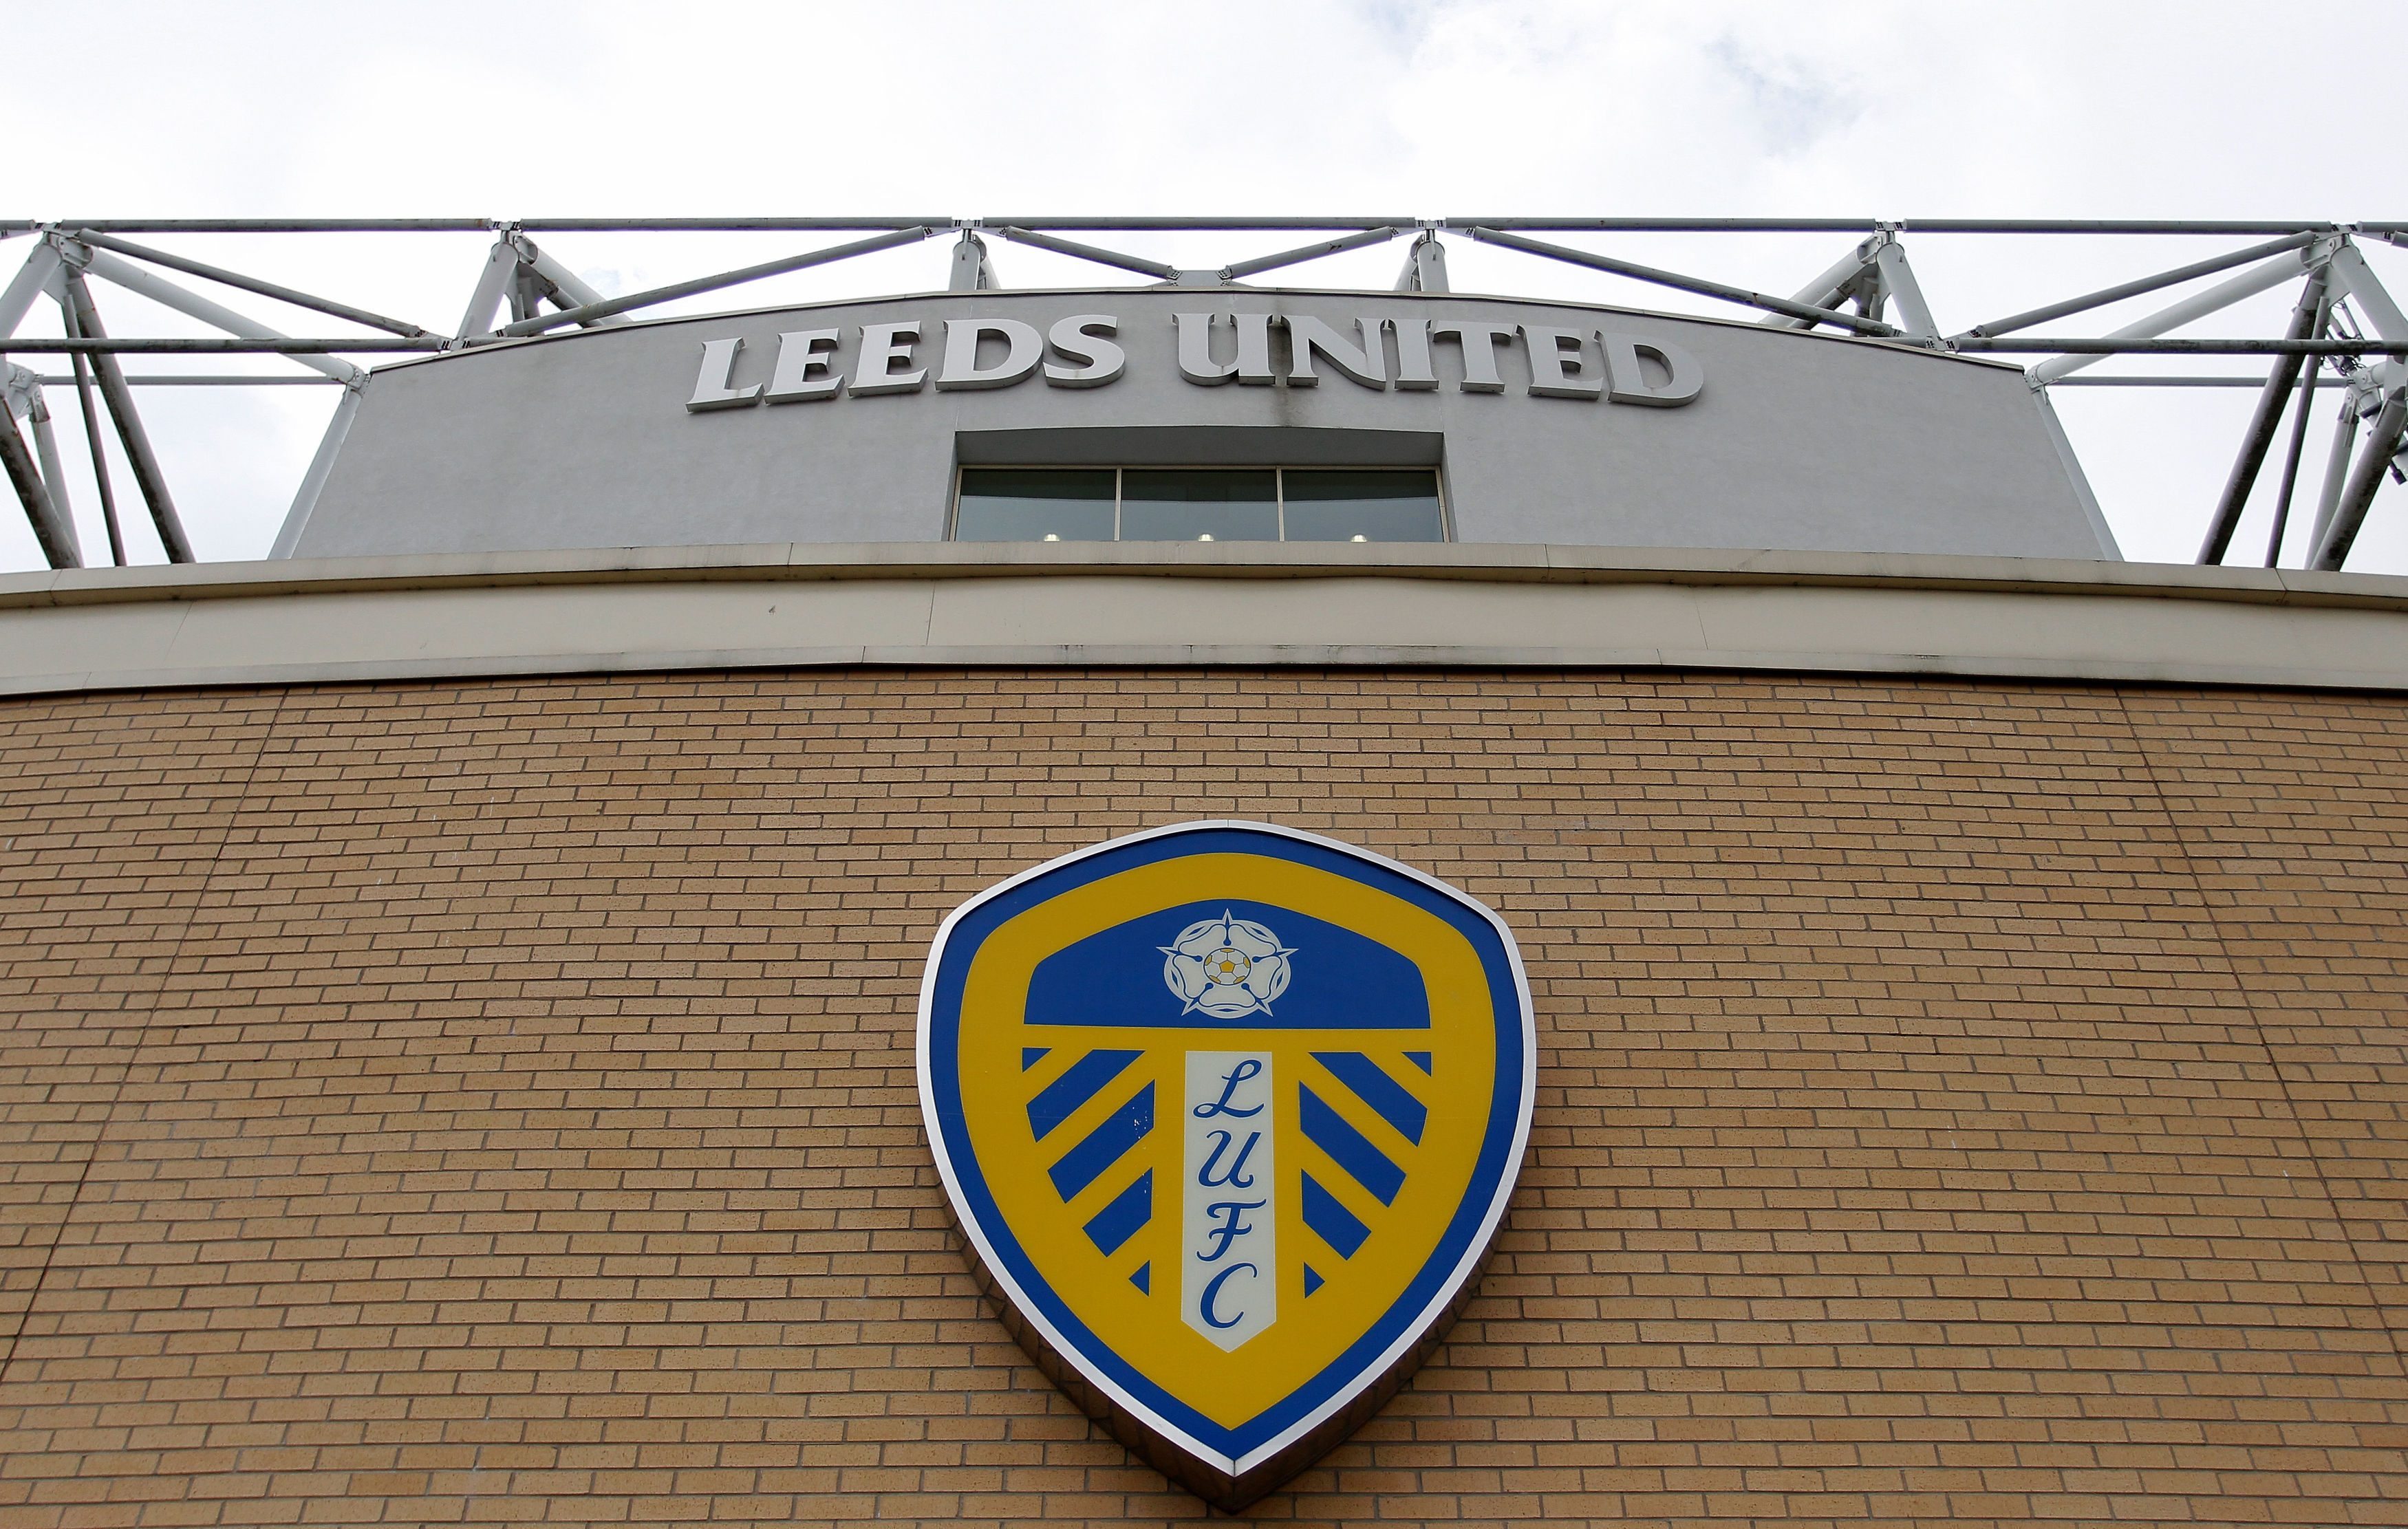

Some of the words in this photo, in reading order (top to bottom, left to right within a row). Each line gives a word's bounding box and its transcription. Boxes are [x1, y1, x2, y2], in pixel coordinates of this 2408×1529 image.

[687, 314, 1126, 411] LEEDS
[1171, 312, 1705, 408] UNITED
[1193, 1059, 1267, 1329] LUFC
